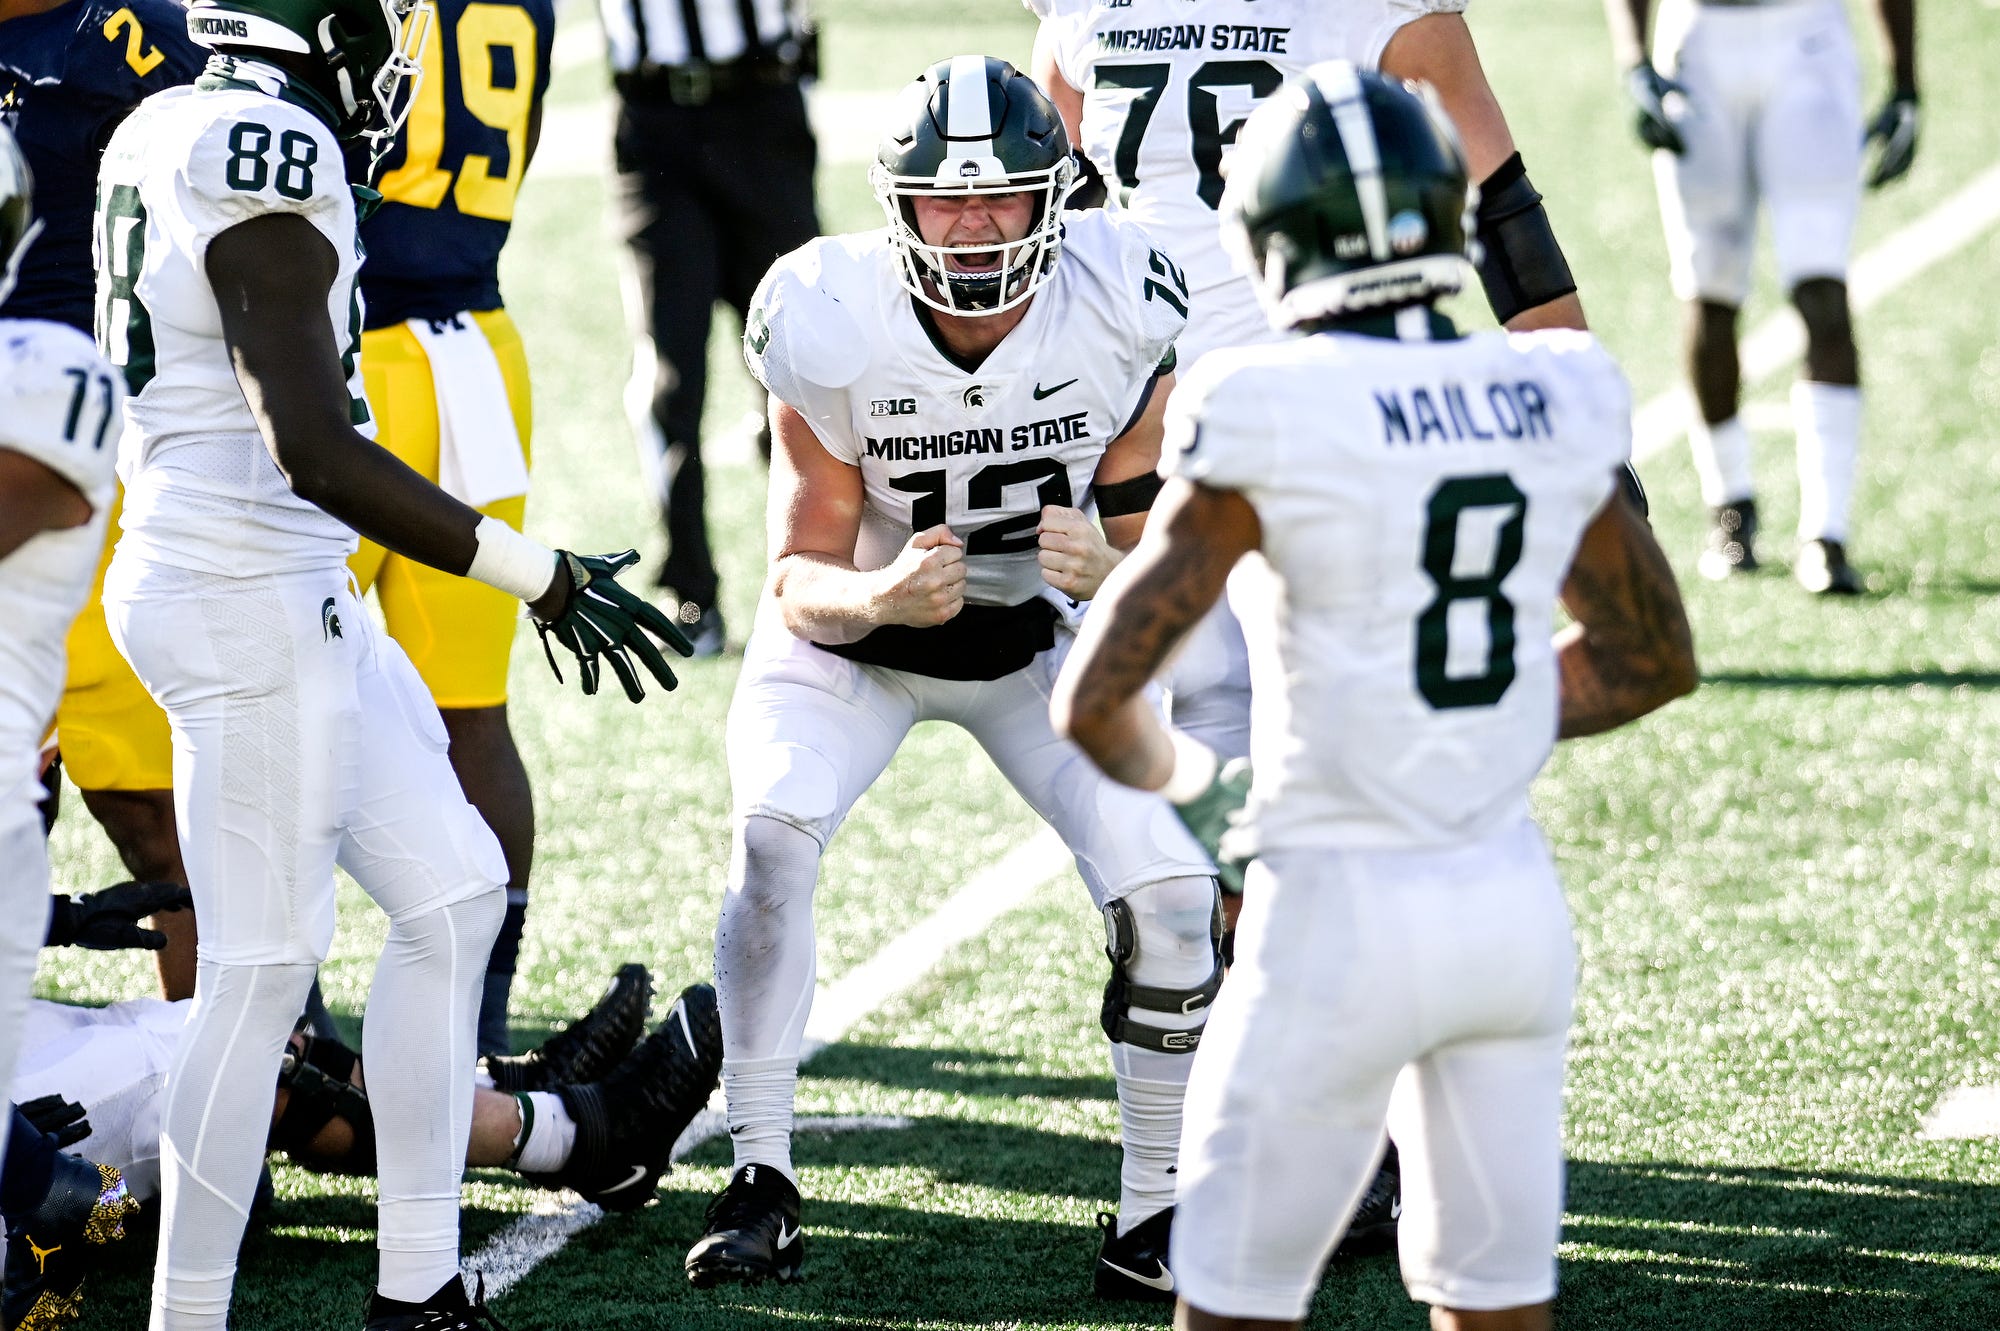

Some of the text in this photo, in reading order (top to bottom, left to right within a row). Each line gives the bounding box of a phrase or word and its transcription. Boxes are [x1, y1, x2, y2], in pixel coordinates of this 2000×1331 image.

[103, 7, 165, 77] 2
[1097, 25, 1291, 54] MICHIGAN STATE
[377, 2, 537, 221] 19
[1094, 60, 1284, 211] 76
[226, 122, 318, 200] 88
[1144, 248, 1189, 320] 12
[864, 411, 1091, 461] MICHIGAN STATE
[1374, 379, 1554, 445] NAILOR
[889, 457, 1073, 555] 12
[1414, 472, 1528, 711] 8
